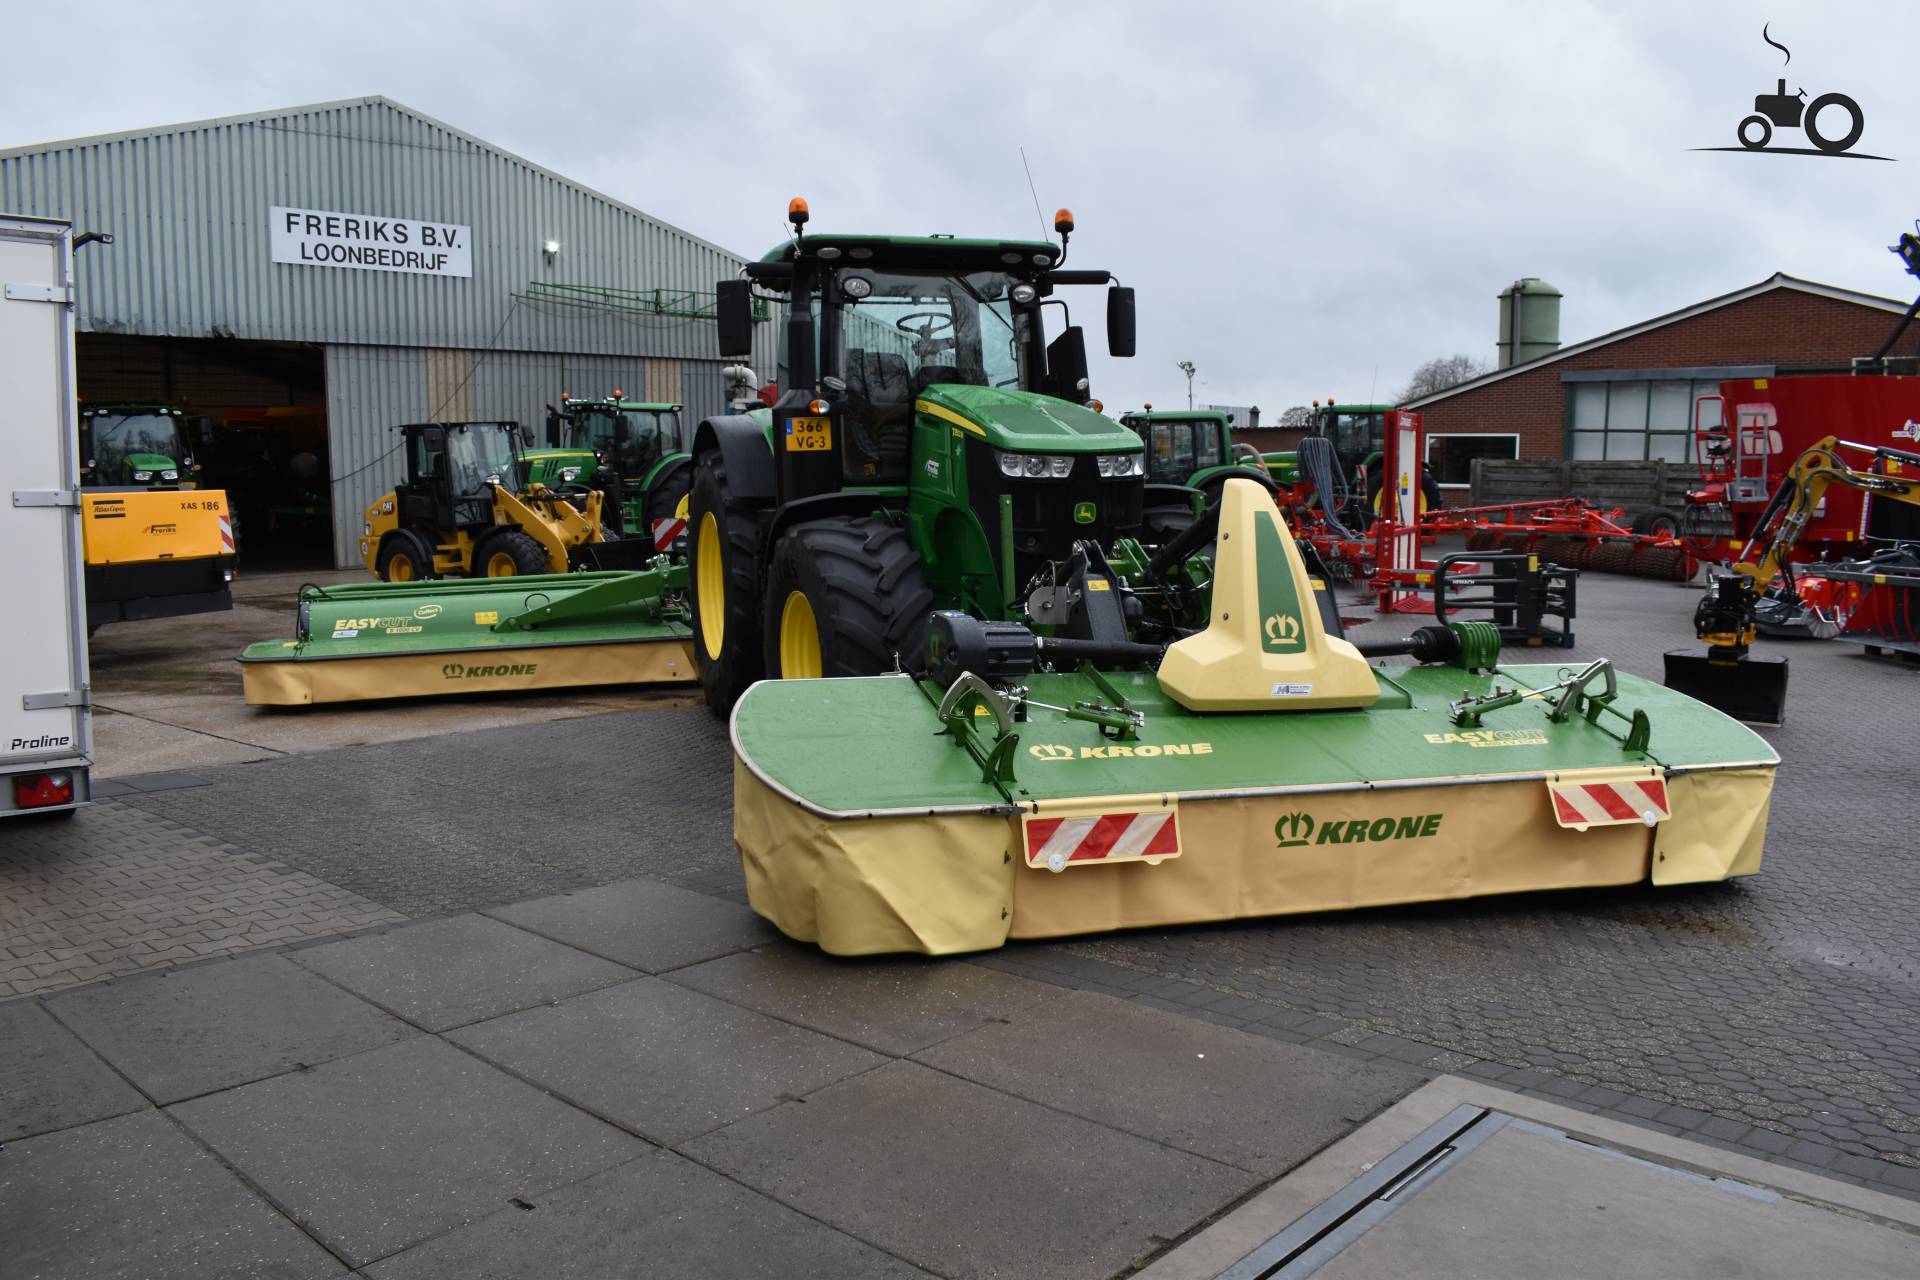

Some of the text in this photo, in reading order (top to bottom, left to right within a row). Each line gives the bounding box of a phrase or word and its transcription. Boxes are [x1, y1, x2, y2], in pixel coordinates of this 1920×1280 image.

[286, 212, 462, 249] FRERIKS B.V.
[301, 242, 448, 271] LOONBEDRIJF
[797, 420, 823, 433] 366
[796, 436, 826, 448] VG-3
[180, 501, 220, 511] XAS 186
[466, 663, 538, 678] KRONE
[11, 735, 70, 751] Proline
[1080, 742, 1214, 759] KRONE
[1315, 813, 1444, 845] KRONE
